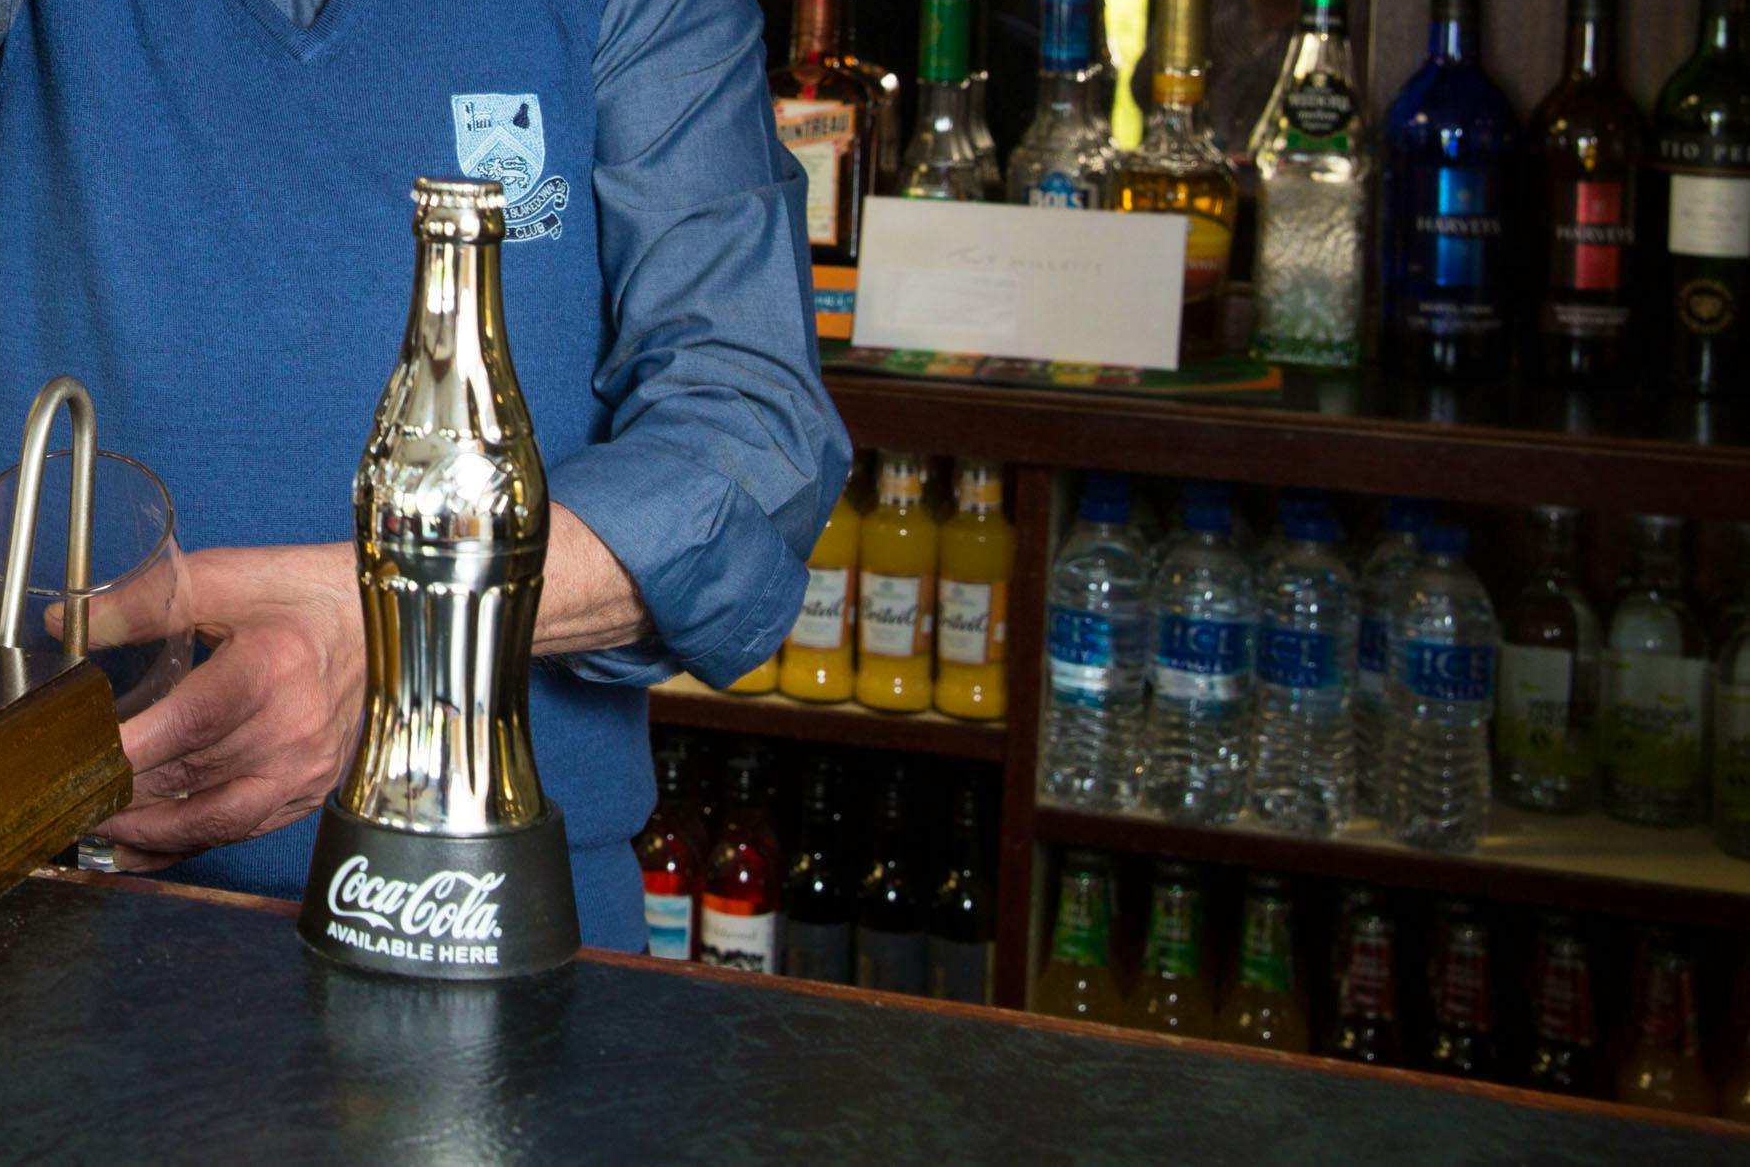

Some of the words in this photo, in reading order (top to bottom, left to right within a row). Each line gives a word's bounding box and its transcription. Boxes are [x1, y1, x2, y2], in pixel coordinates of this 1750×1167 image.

[1659, 140, 1700, 159] TIO
[509, 181, 556, 219] BLAKEDOWN
[1028, 187, 1084, 209] BOLS
[515, 221, 546, 239] CLUB
[1415, 214, 1503, 235] HARVEYS
[1555, 223, 1637, 245] HARVEYS
[1421, 647, 1487, 682] ICE
[327, 854, 506, 940] Coca-Cola
[327, 920, 435, 962] AVAILABLE
[438, 945, 500, 965] HERE
